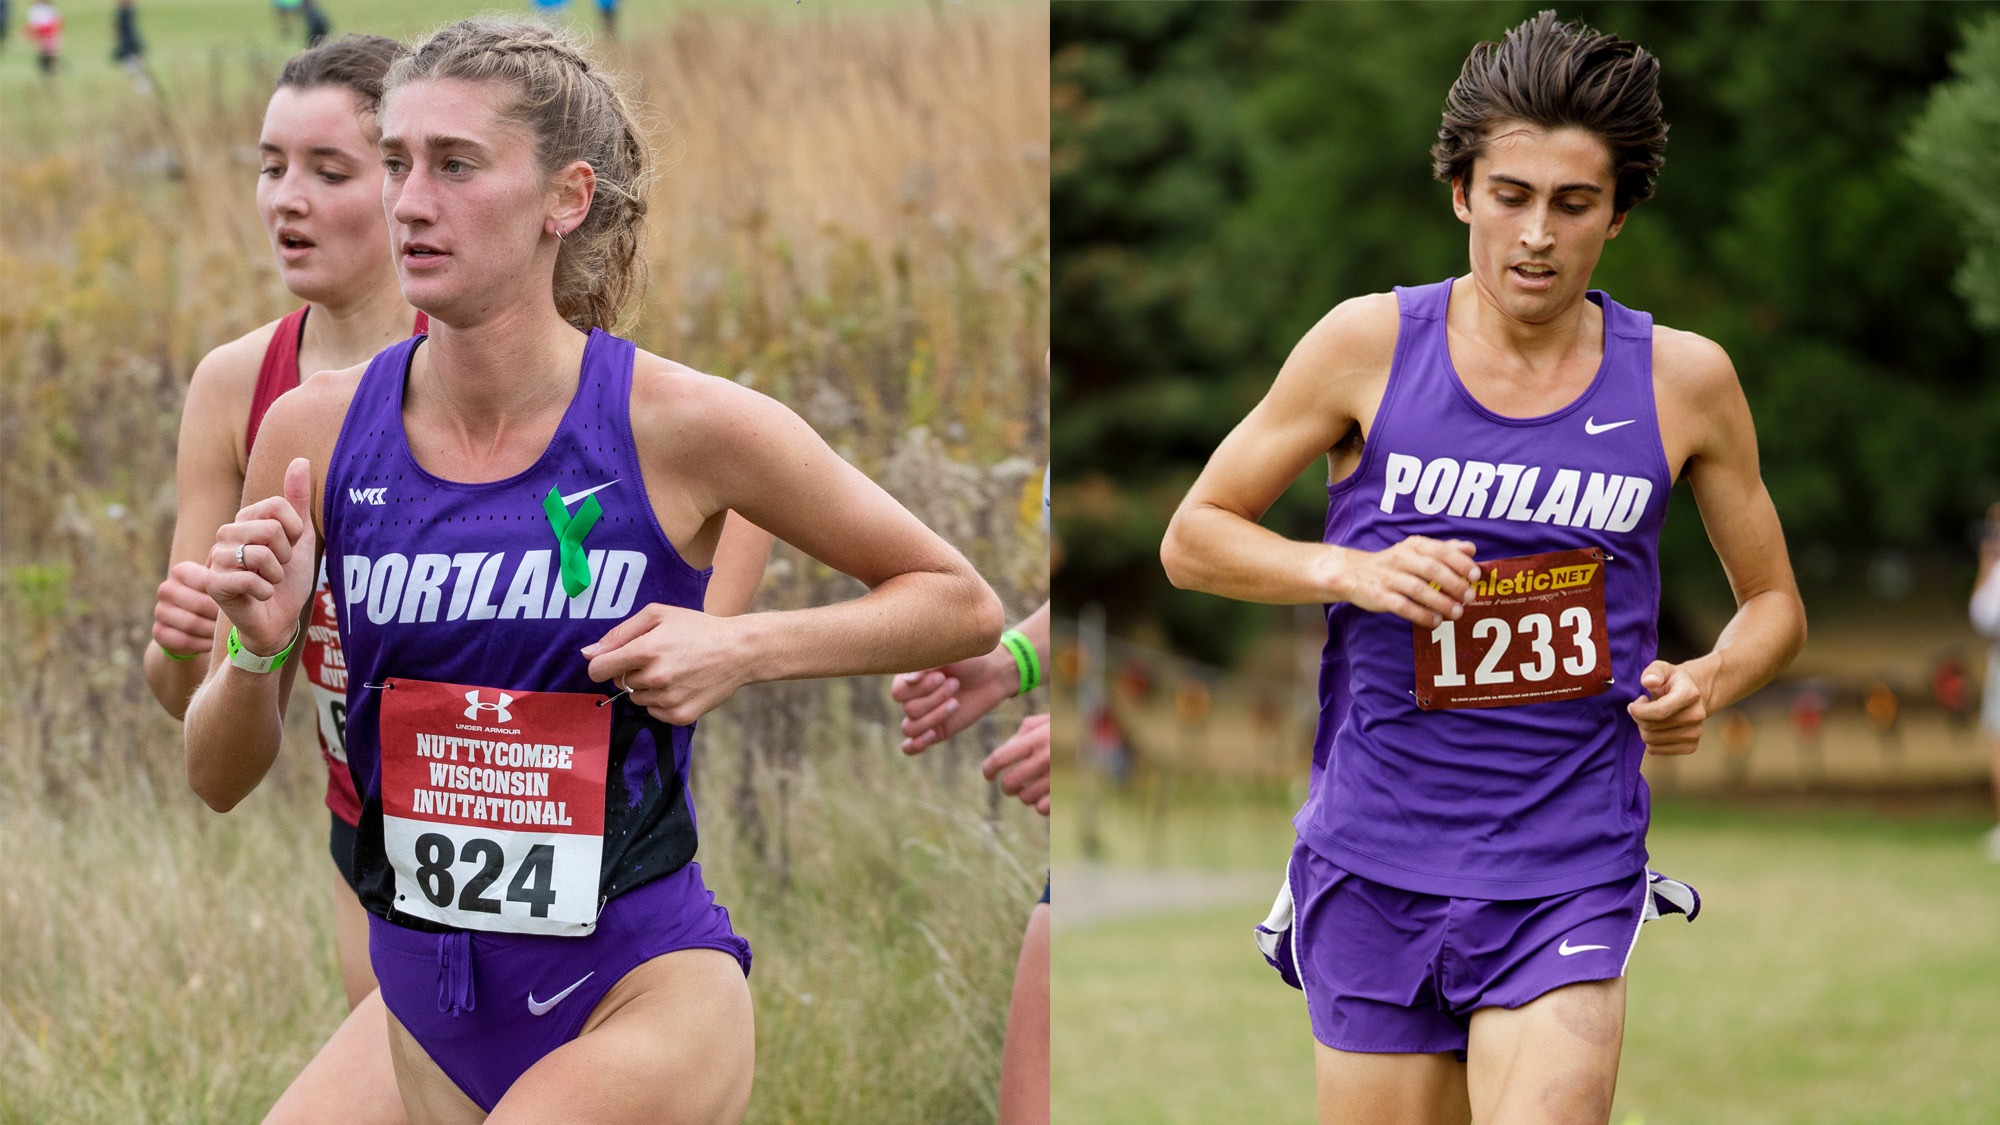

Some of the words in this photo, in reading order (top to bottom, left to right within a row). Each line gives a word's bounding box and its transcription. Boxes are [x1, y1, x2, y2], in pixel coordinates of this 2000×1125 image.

[1379, 452, 1653, 533] PORTLAND
[1556, 568, 1591, 585] NET
[1431, 606, 1597, 687] 1233
[455, 723, 483, 732] UNDER
[484, 726, 521, 735] ARMOUR
[416, 733, 574, 770] NUTTYCOMBE
[429, 762, 549, 797] WISCONSIN
[412, 789, 573, 826] INVITATIONAL
[414, 832, 557, 919] 824
